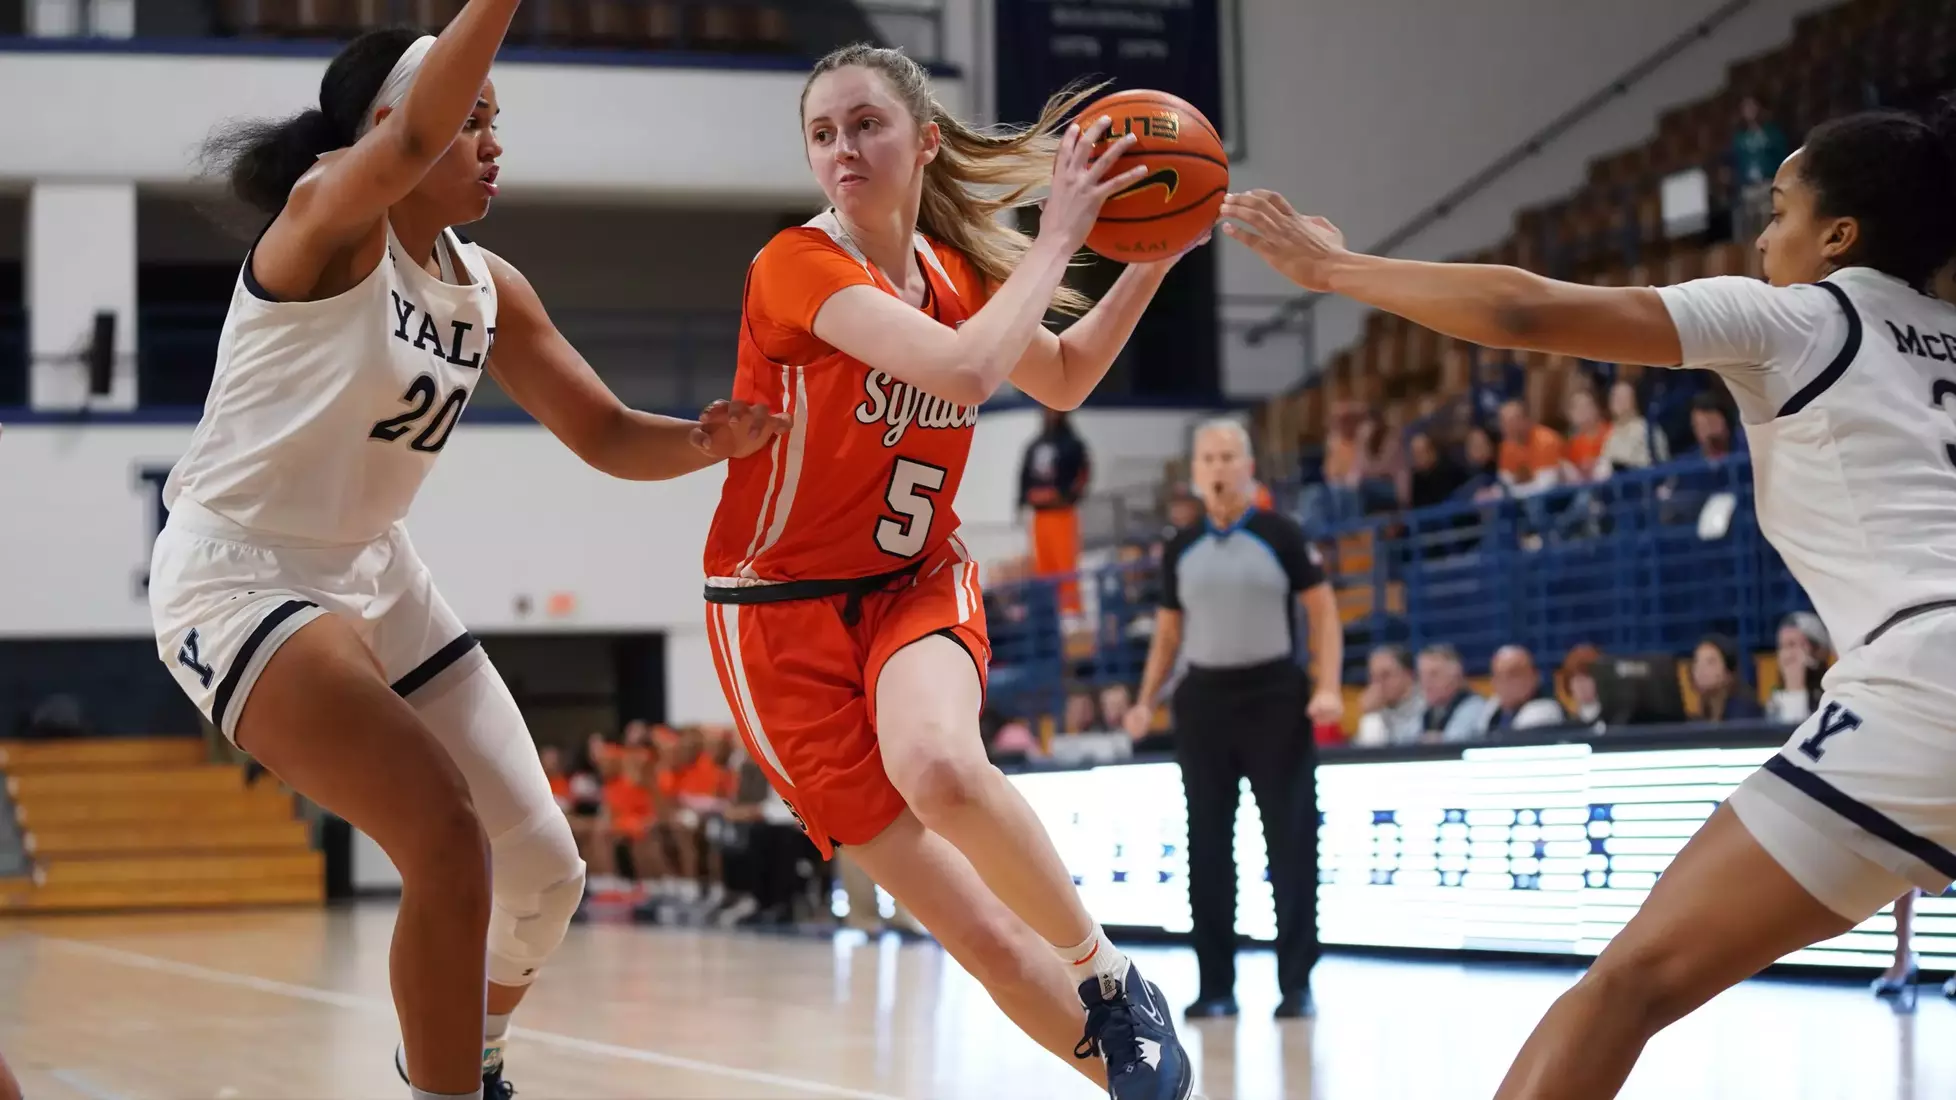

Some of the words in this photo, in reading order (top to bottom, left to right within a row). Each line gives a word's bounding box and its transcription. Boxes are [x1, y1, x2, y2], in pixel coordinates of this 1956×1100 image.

[1090, 113, 1179, 143] ELIT
[369, 371, 468, 454] 20
[872, 455, 948, 560] 5
[177, 627, 215, 690] Y
[1797, 700, 1863, 763] Y
